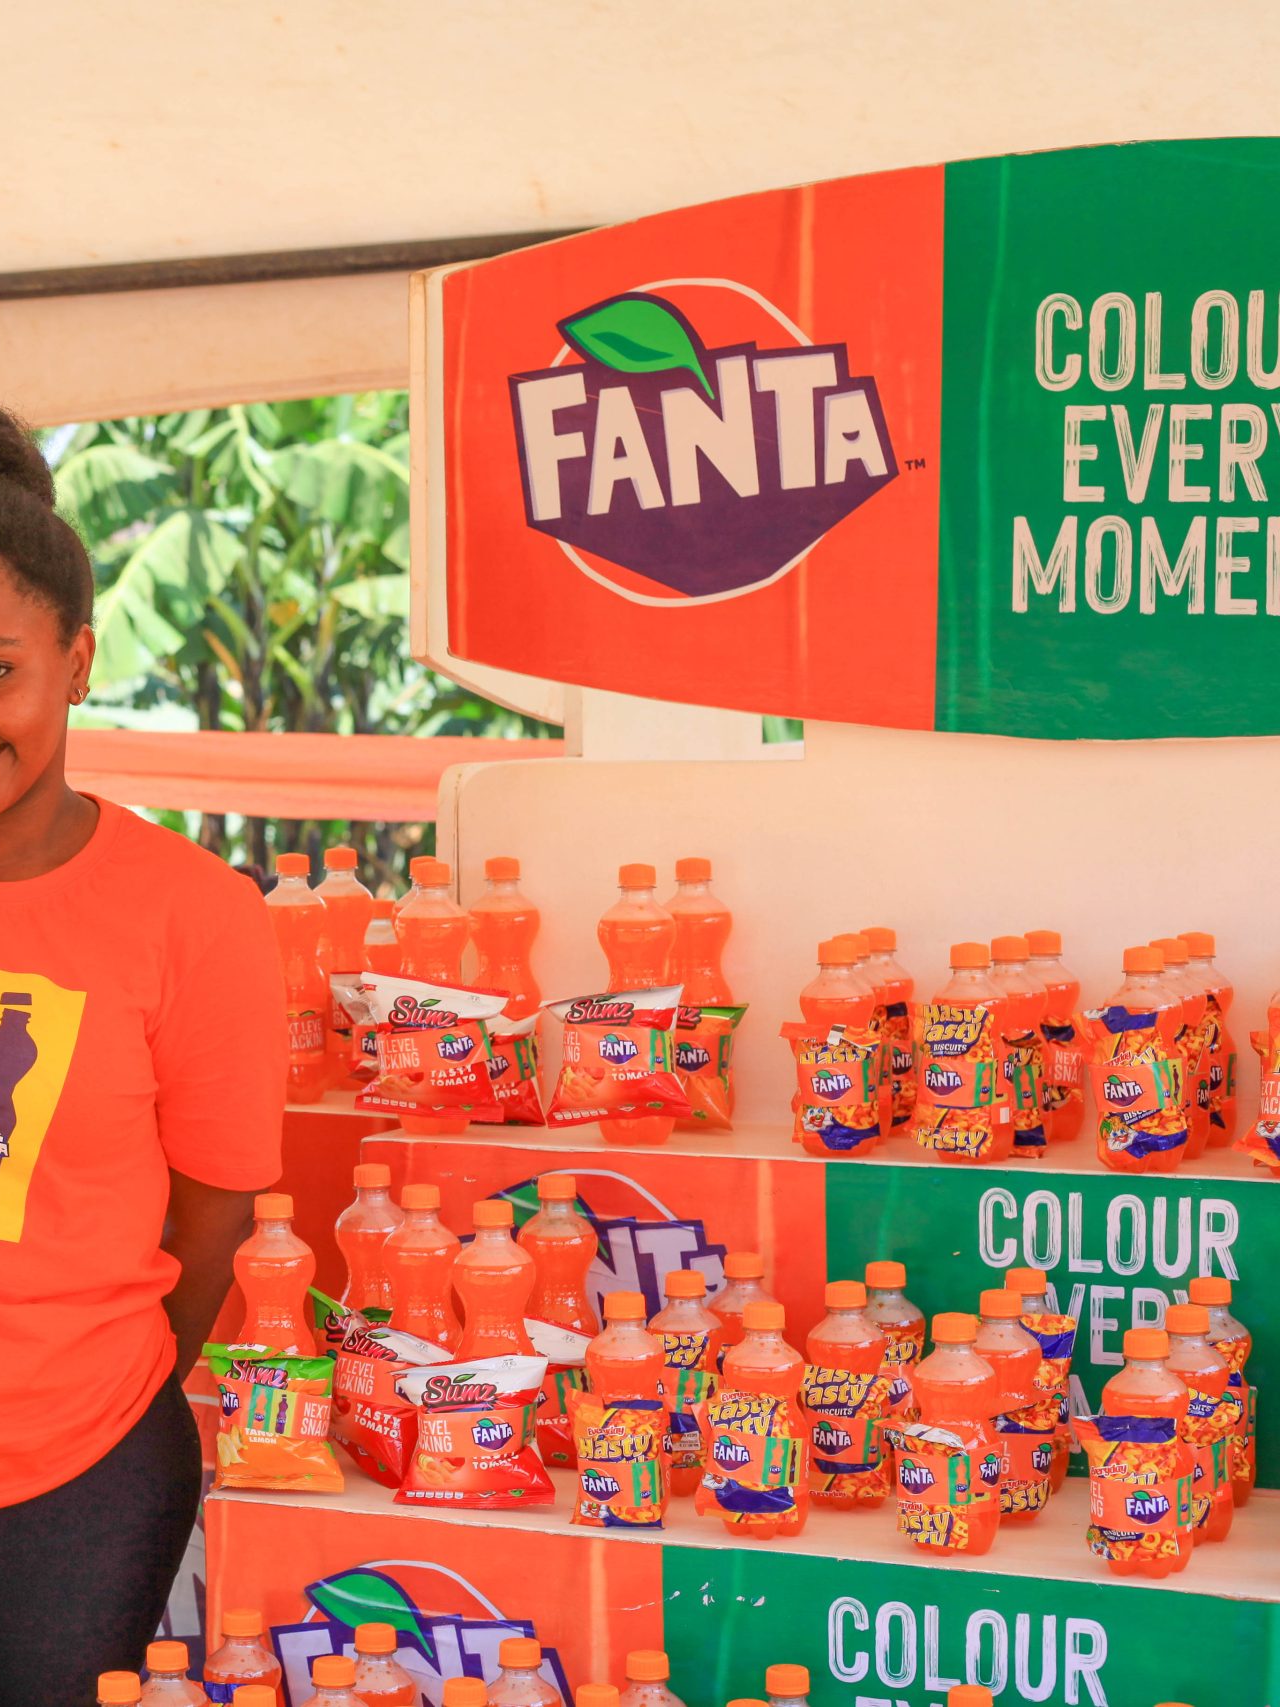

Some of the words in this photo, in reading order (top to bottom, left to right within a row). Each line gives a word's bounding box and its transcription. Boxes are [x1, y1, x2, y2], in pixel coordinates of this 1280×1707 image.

[1034, 289, 1280, 391] COLOU
[516, 351, 889, 522] FANTA
[1063, 403, 1280, 504] EVER
[1012, 514, 1280, 615] MOME
[386, 1038, 418, 1053] LEVEL
[437, 1036, 474, 1058] FANTA
[599, 1040, 638, 1057] FANTA
[430, 1073, 477, 1087] TOMATO
[811, 1074, 852, 1093] FANTA
[925, 1071, 962, 1087] FANTA
[1103, 1081, 1142, 1098] FANTA
[978, 1187, 1240, 1281] COLOUR
[347, 1360, 375, 1379] LEVEL
[354, 1415, 400, 1438] TOMATO
[472, 1423, 513, 1443] FANTA
[813, 1427, 851, 1446] FANTA
[713, 1443, 750, 1461] FANTA
[581, 1475, 620, 1491] FANTA
[900, 1466, 934, 1484] FANTA
[1126, 1497, 1170, 1515] FANTA
[827, 1596, 1109, 1707] COLOUR
